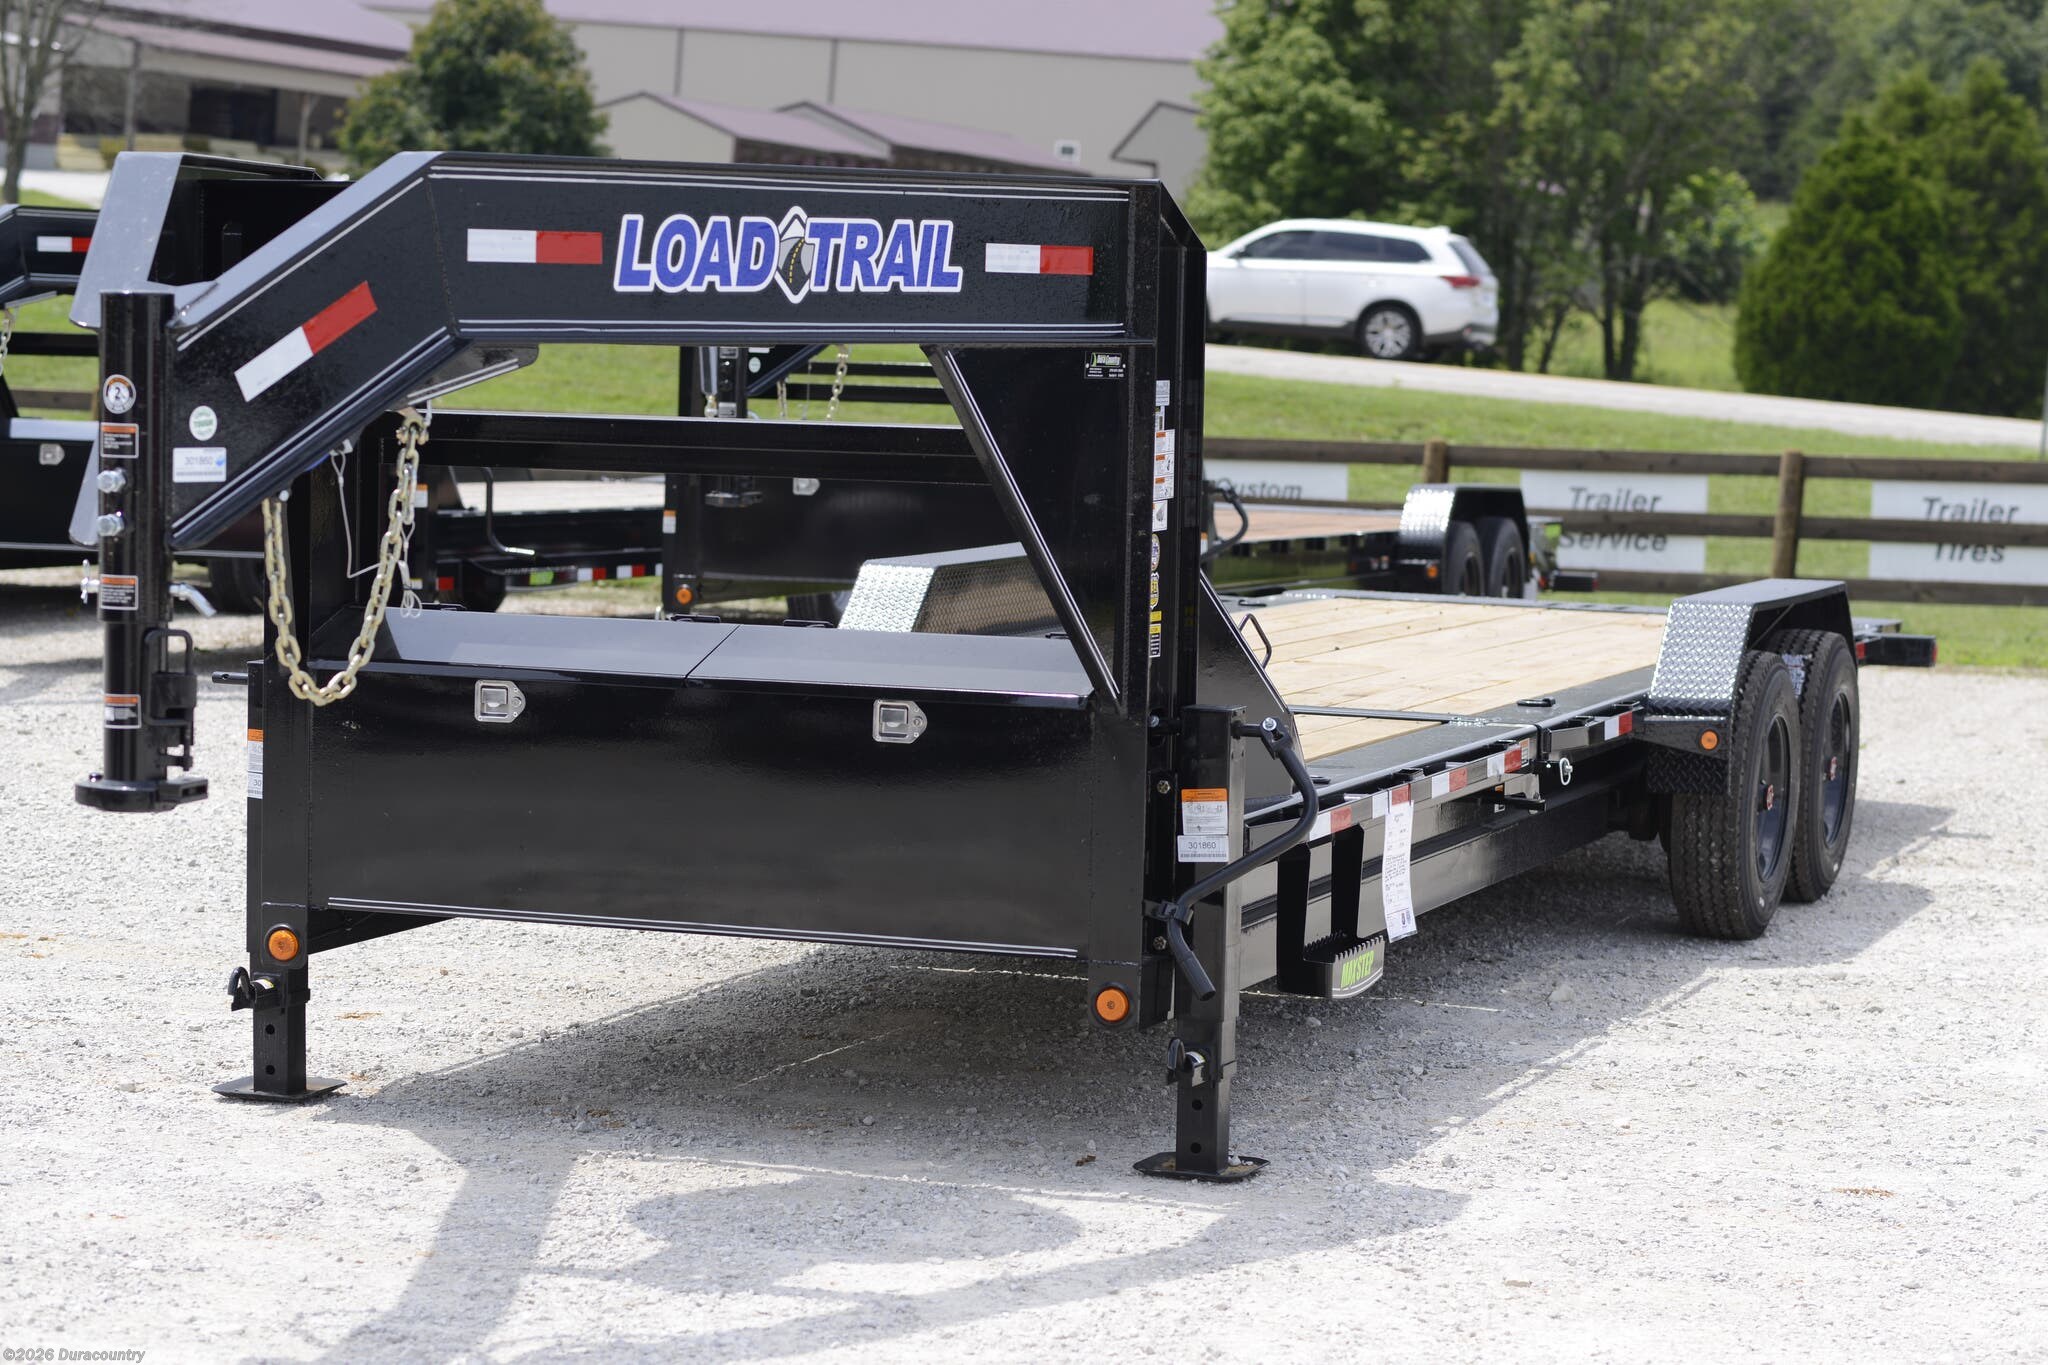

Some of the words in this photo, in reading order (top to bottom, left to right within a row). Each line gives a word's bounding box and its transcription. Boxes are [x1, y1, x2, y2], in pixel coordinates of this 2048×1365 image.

[614, 214, 780, 293] LOAD
[805, 216, 963, 293] TRAIL
[1570, 486, 1662, 512] Trailer
[1923, 497, 2019, 523] Trailer
[1560, 532, 1667, 552] Service
[1188, 841, 1217, 850] 301860
[1341, 957, 1358, 988] MAX
[1356, 950, 1375, 980] STEP
